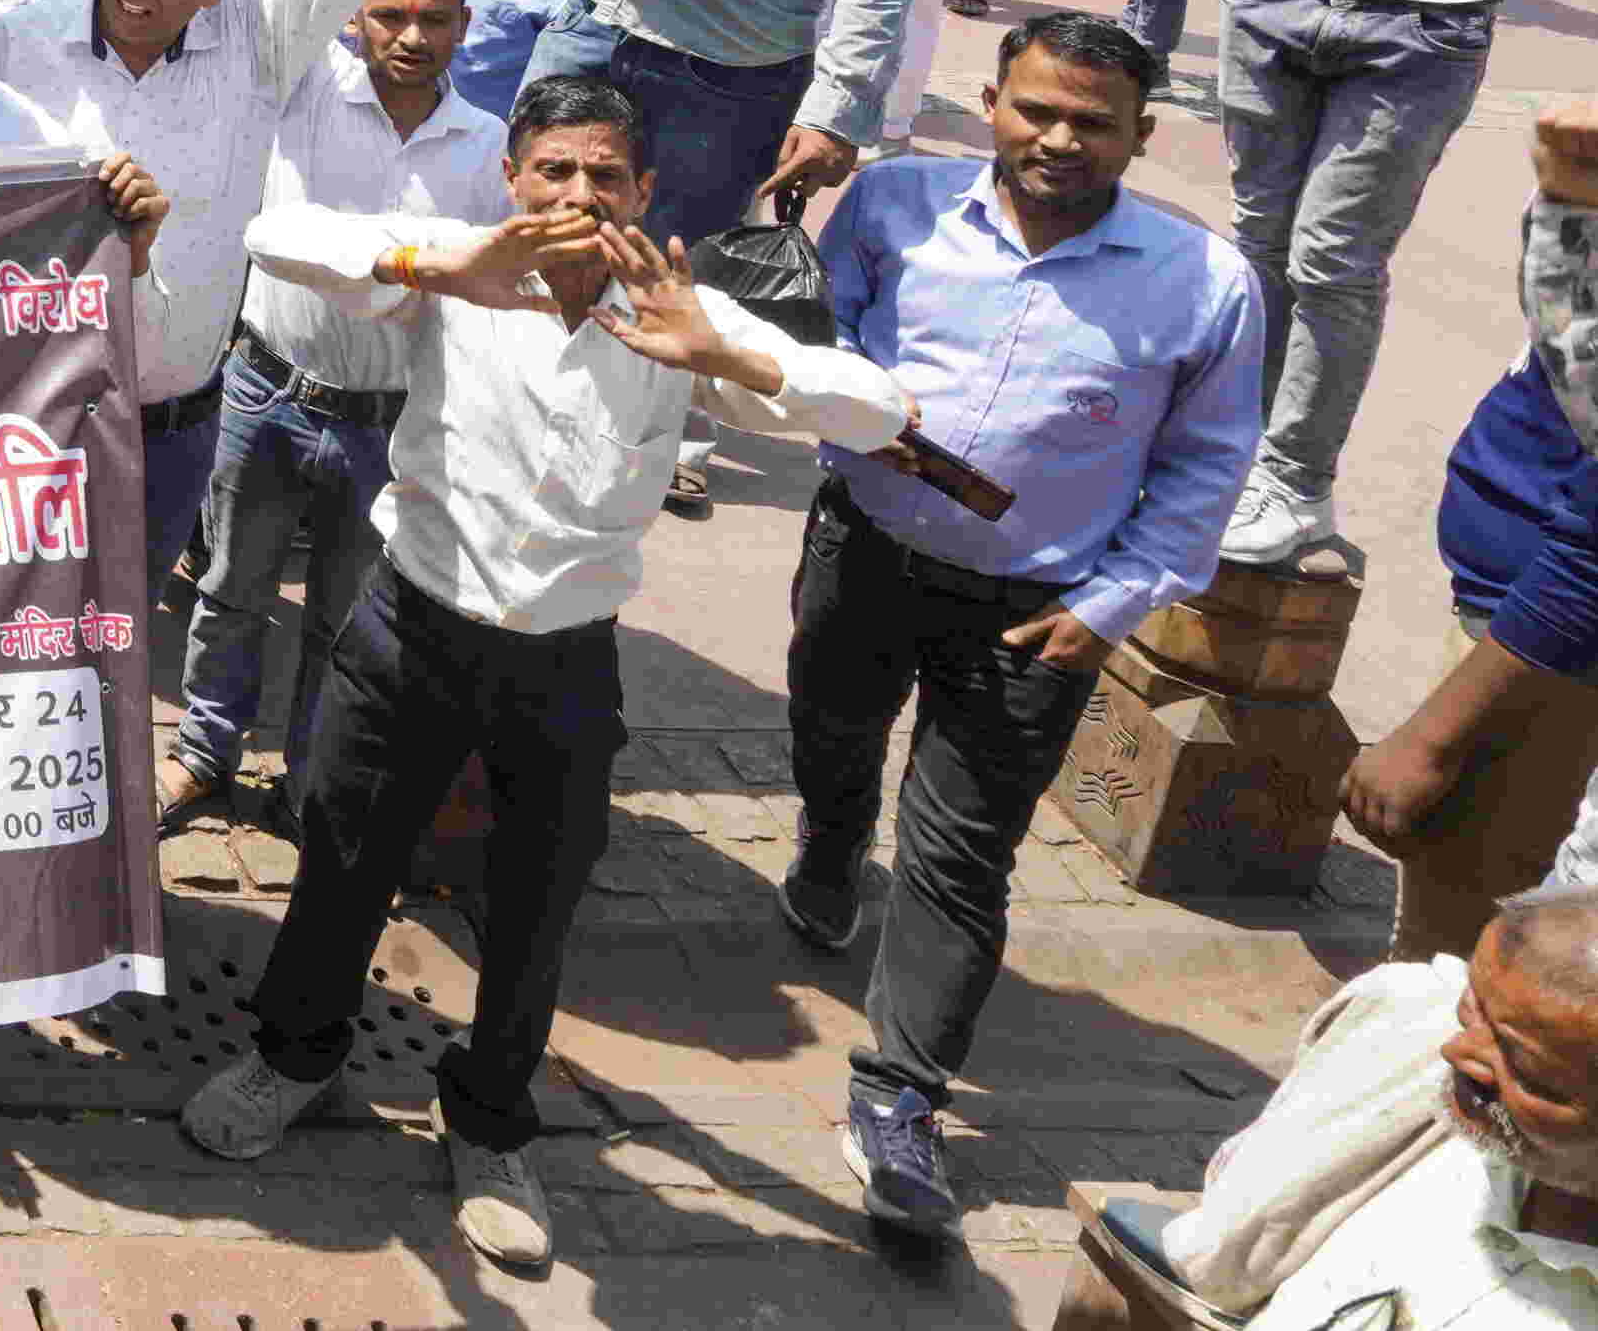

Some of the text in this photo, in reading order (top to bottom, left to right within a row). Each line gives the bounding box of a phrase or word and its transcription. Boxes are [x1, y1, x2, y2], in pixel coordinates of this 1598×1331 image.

[35, 689, 88, 728] 24
[8, 744, 103, 792] 2025
[52, 790, 98, 833] बजे
